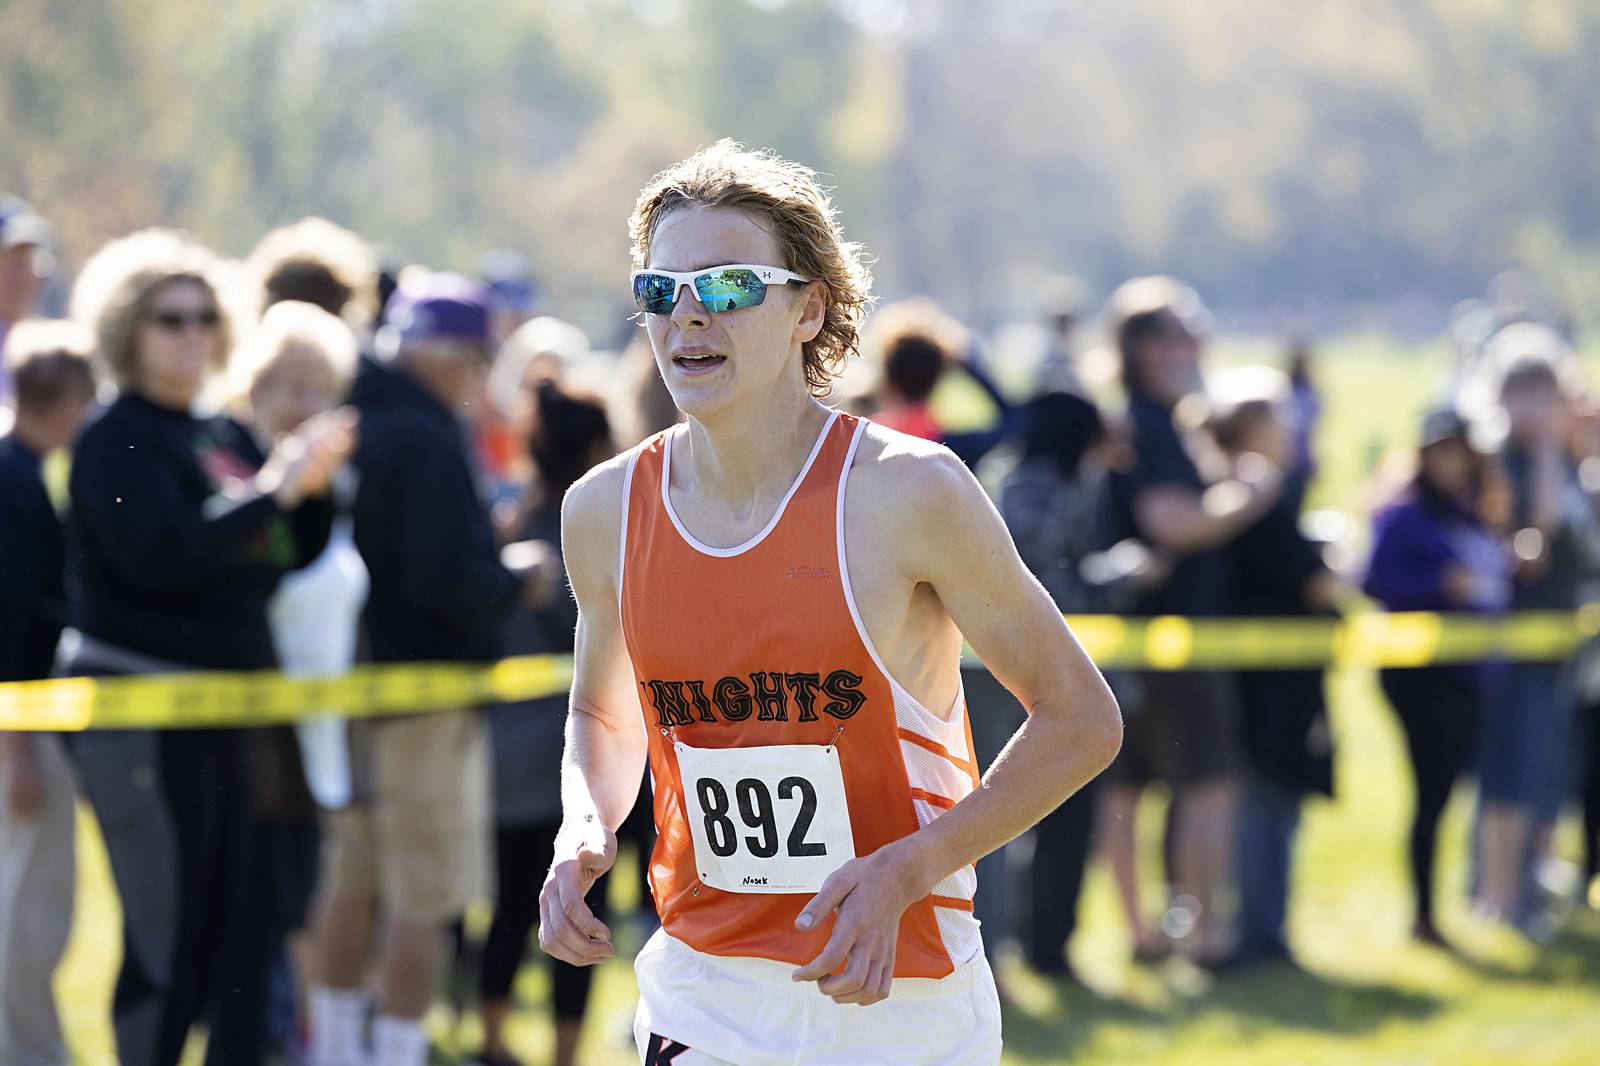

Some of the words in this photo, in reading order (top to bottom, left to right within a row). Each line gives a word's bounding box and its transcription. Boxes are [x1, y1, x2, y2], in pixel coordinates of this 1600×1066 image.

[641, 670, 867, 726] NIGHTS
[696, 776, 827, 858] 892
[743, 876, 768, 885] Nosek
